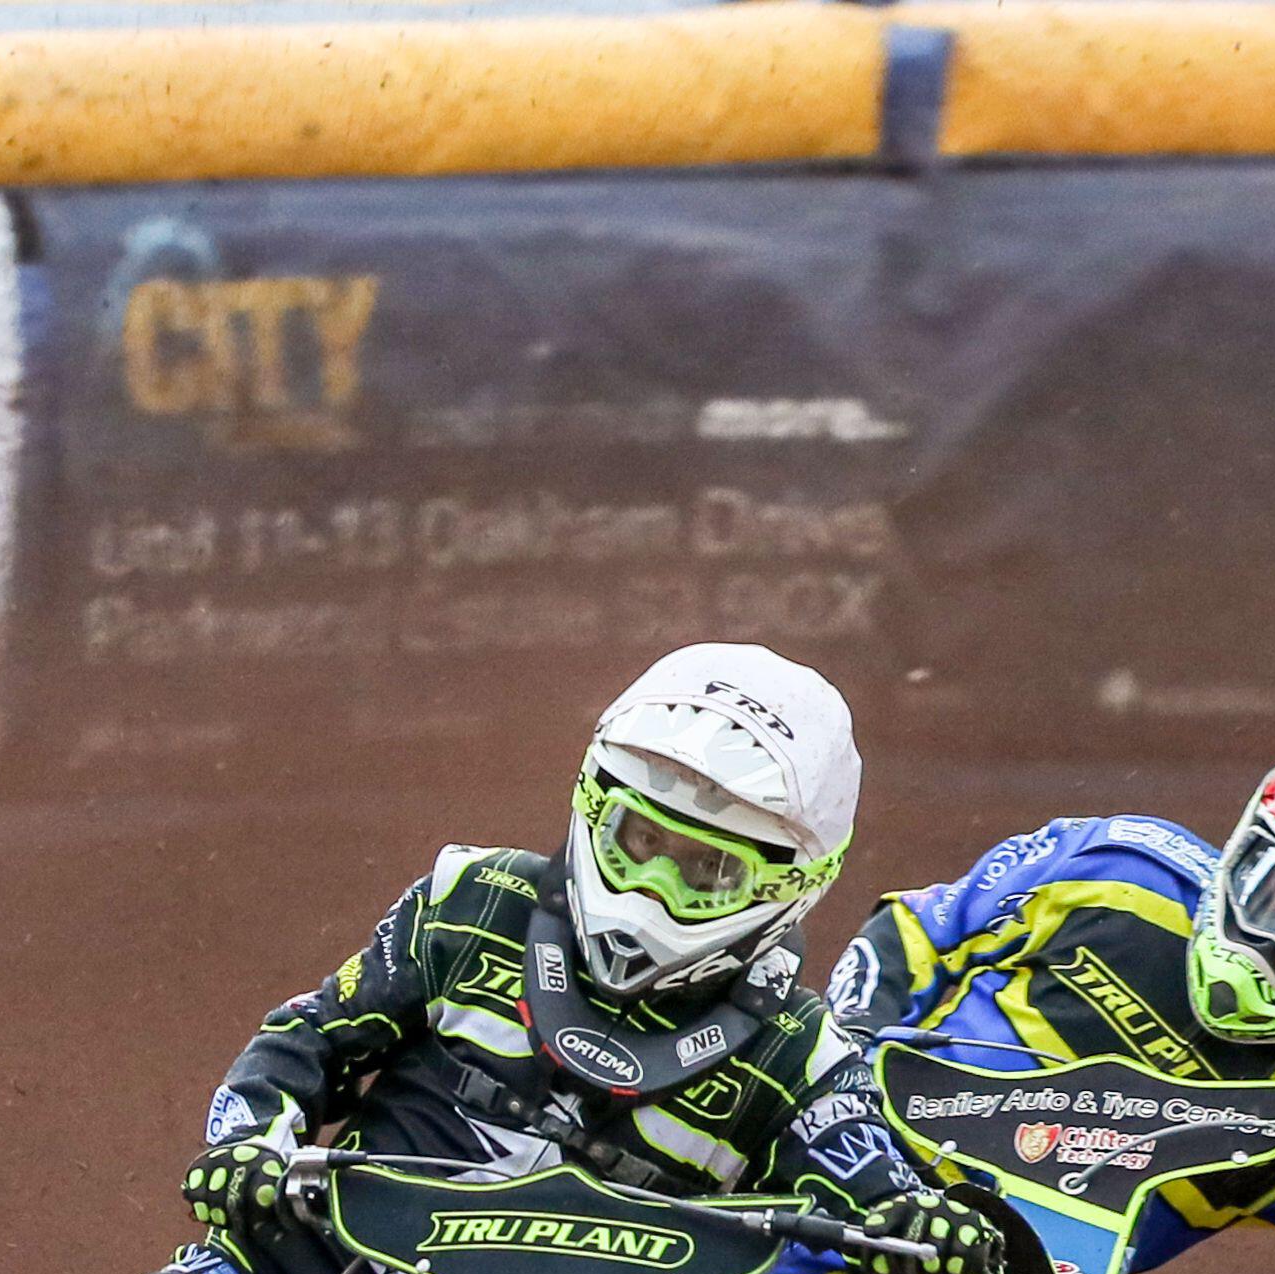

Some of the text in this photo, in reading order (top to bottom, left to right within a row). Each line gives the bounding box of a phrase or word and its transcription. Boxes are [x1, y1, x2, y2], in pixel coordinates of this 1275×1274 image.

[1070, 963, 1155, 1036] TRU
[561, 1033, 635, 1082] ORTEMA
[908, 1091, 999, 1122] Bentley
[1001, 1087, 1071, 1113] Auto
[1072, 1090, 1100, 1114] &
[1101, 1092, 1158, 1120] Tyre
[441, 1218, 677, 1260] TRU PLANT
